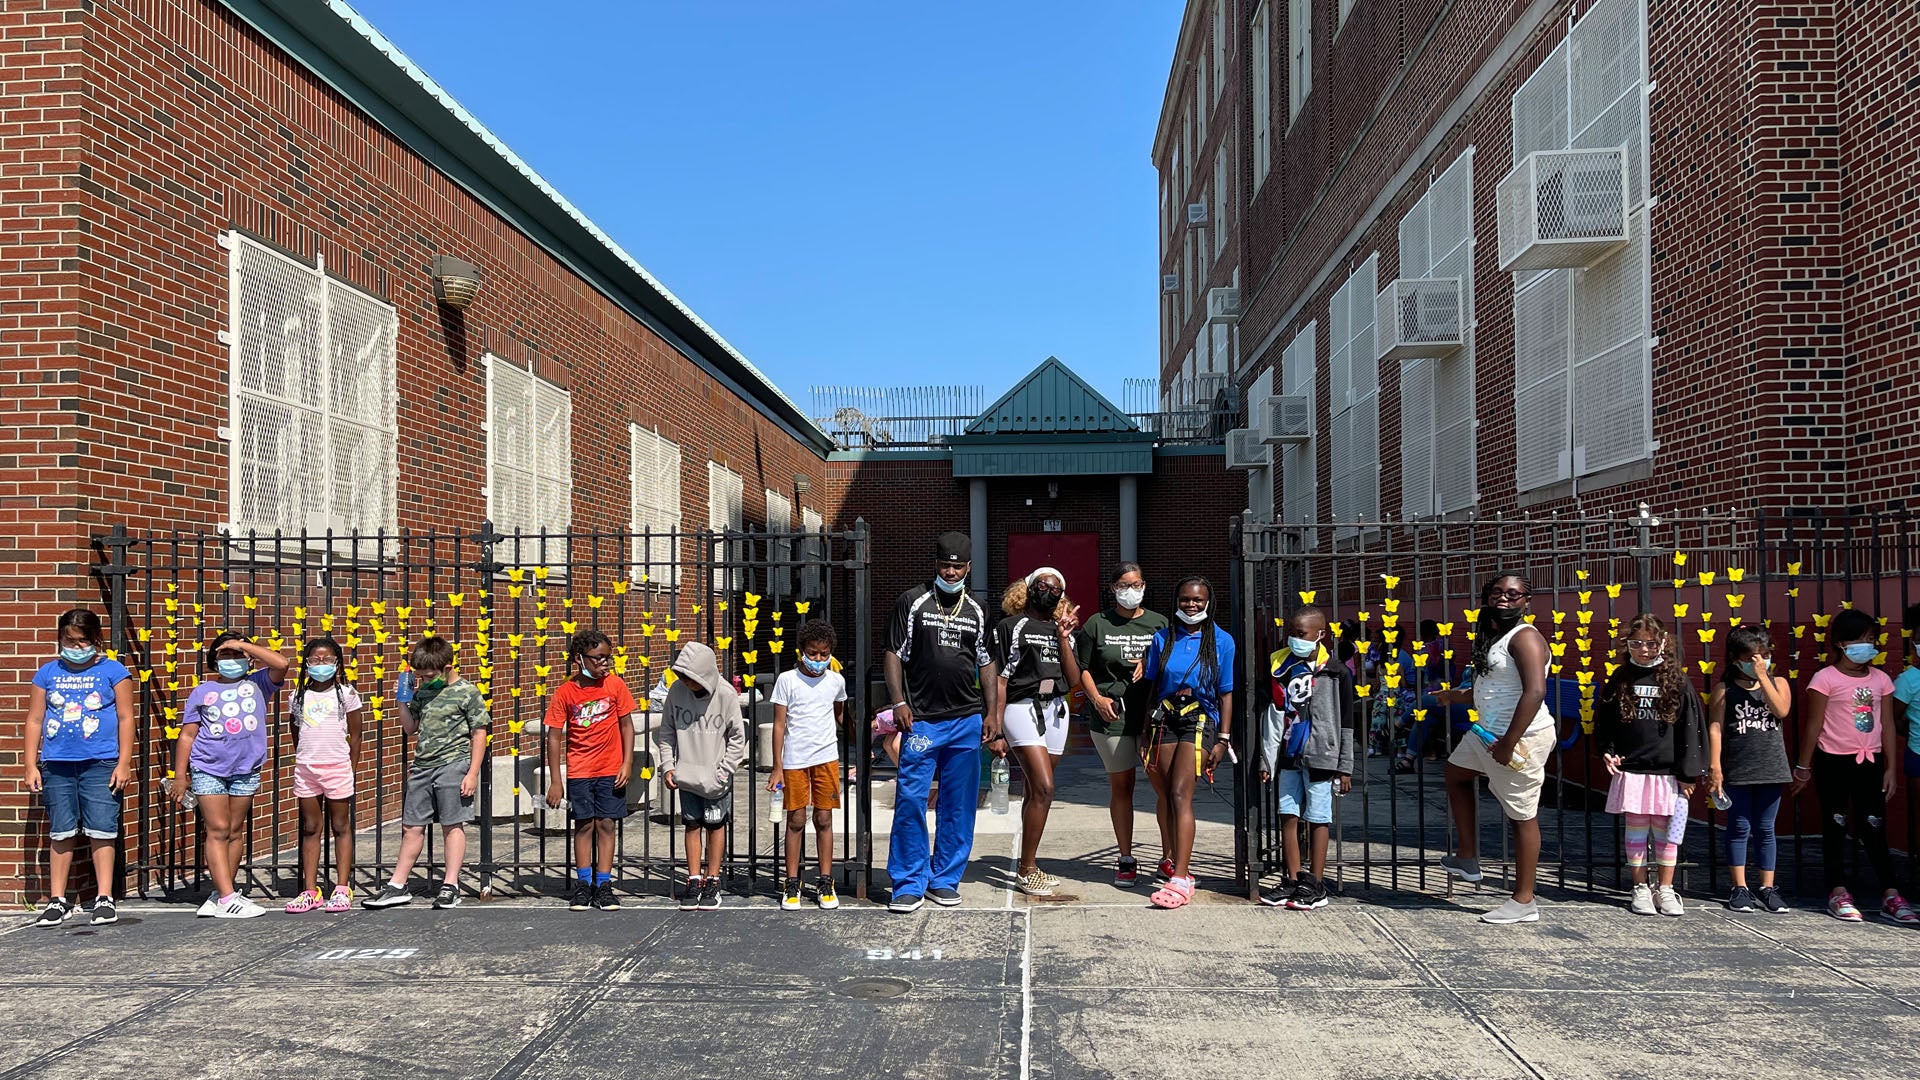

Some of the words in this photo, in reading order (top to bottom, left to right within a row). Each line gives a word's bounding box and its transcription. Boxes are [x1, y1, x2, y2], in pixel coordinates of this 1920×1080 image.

[949, 622, 977, 633] Negative
[62, 675, 82, 683] LOVE
[1639, 698, 1654, 708] IN
[1735, 700, 1770, 719] Strong
[674, 705, 725, 730] TOKYO
[1736, 717, 1779, 734] Hearted
